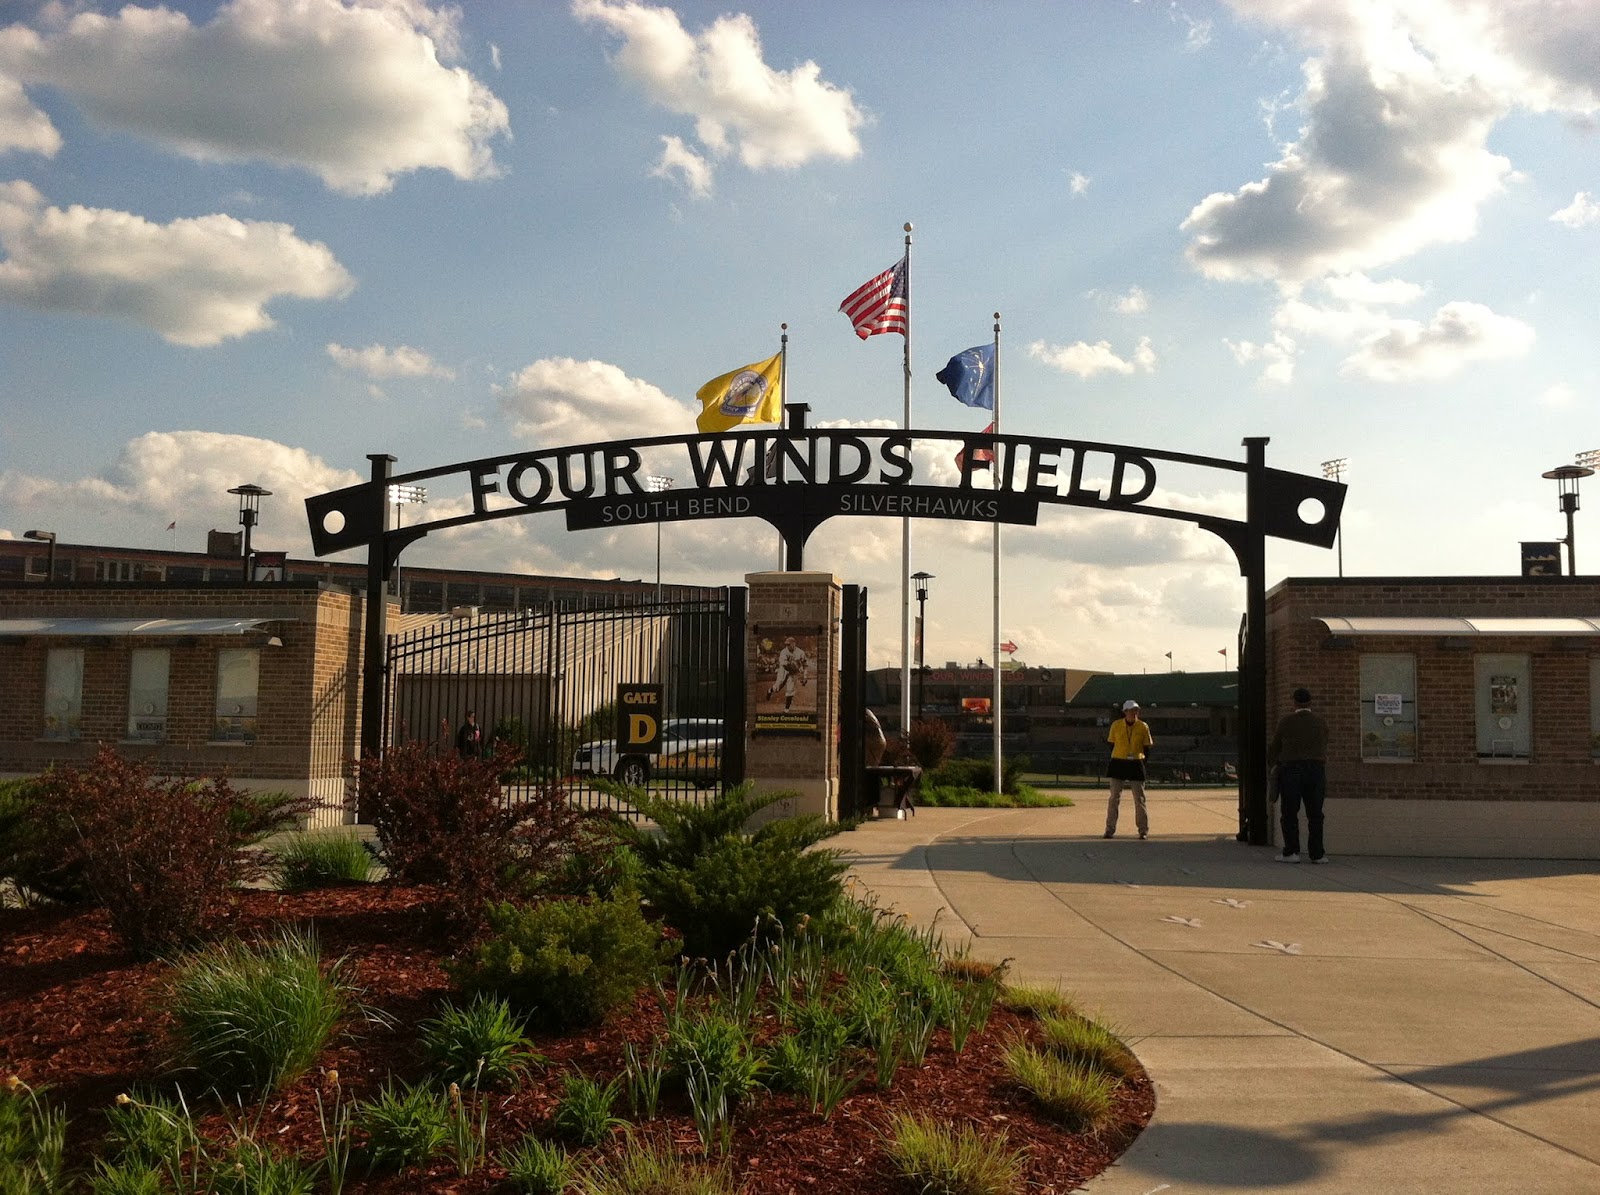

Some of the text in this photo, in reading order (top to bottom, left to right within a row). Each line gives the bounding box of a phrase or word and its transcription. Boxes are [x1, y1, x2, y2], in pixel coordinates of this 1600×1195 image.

[469, 434, 1157, 515] FOUR WINDS FIELD
[601, 496, 751, 523] SOUTH BEND
[839, 493, 999, 519] SILVERHAWKS
[623, 691, 658, 705] GATE
[627, 713, 658, 744] D
